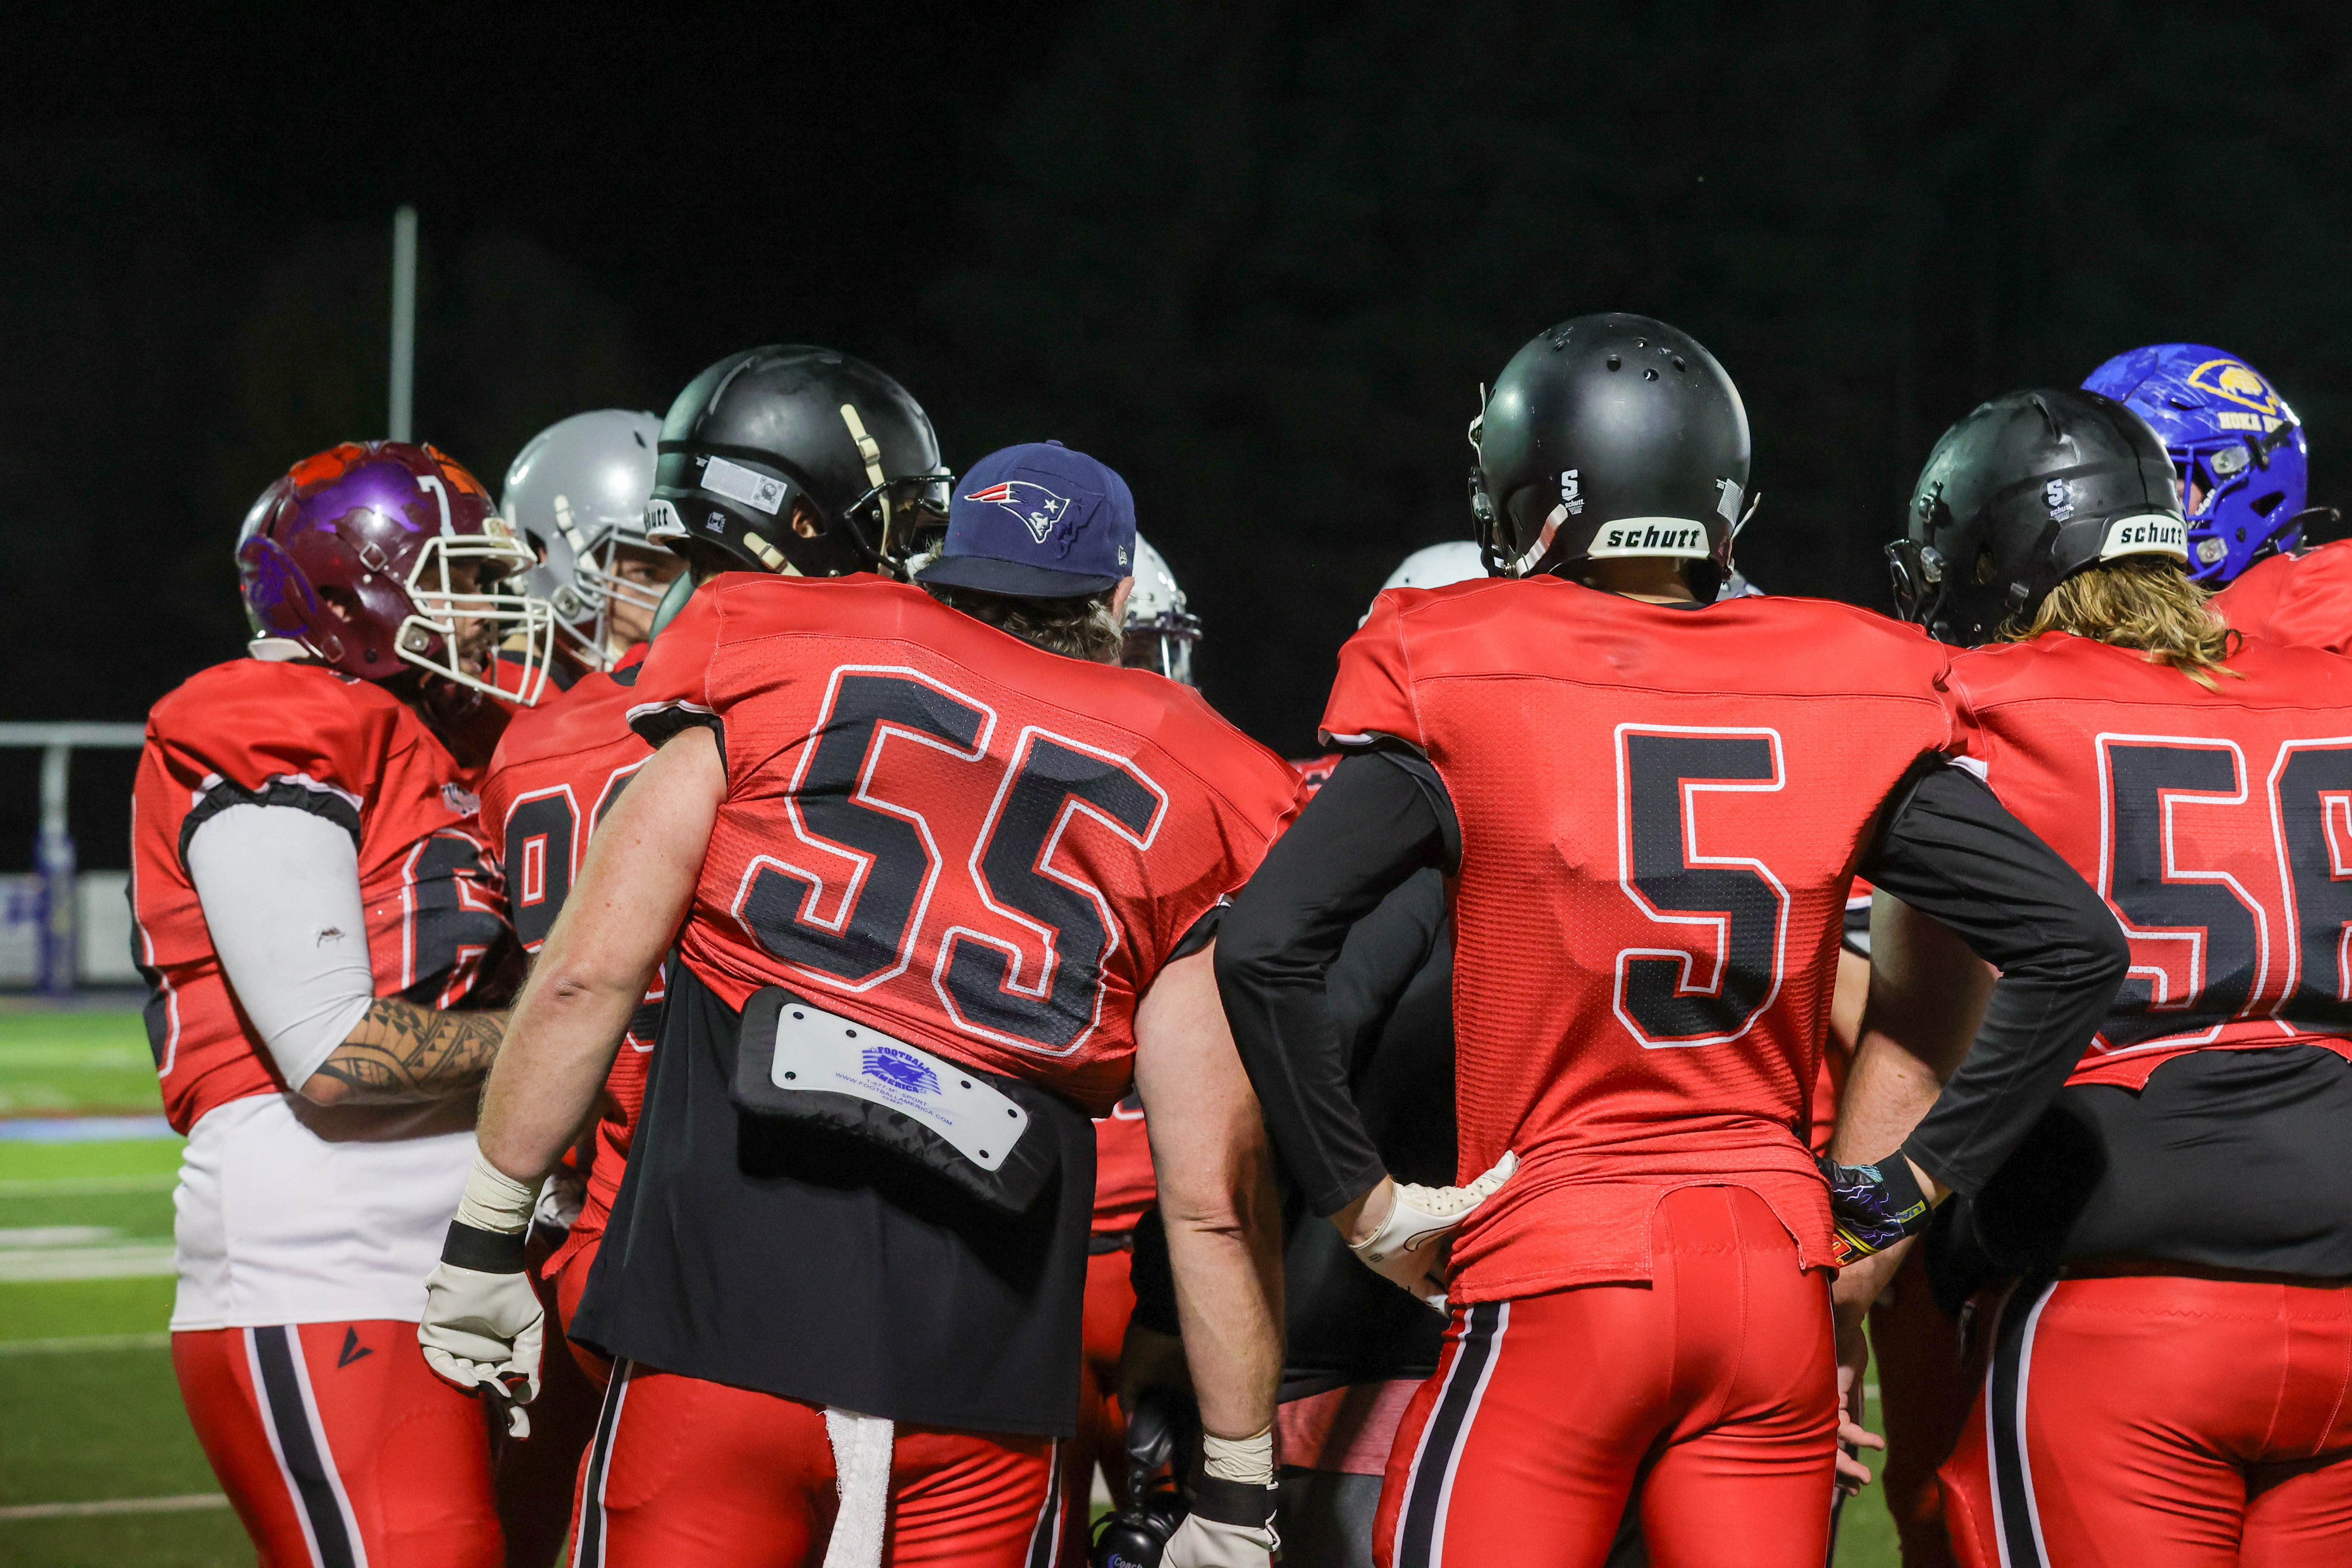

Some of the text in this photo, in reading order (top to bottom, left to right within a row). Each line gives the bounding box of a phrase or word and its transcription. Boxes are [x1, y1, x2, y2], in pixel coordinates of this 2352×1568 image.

[2218, 411, 2263, 431] HOKA
[1565, 499, 1585, 508] schutt
[1607, 524, 1700, 547] schutt
[2120, 521, 2182, 545] schutt
[731, 664, 1168, 1057] 55
[1613, 723, 1791, 1049] 5
